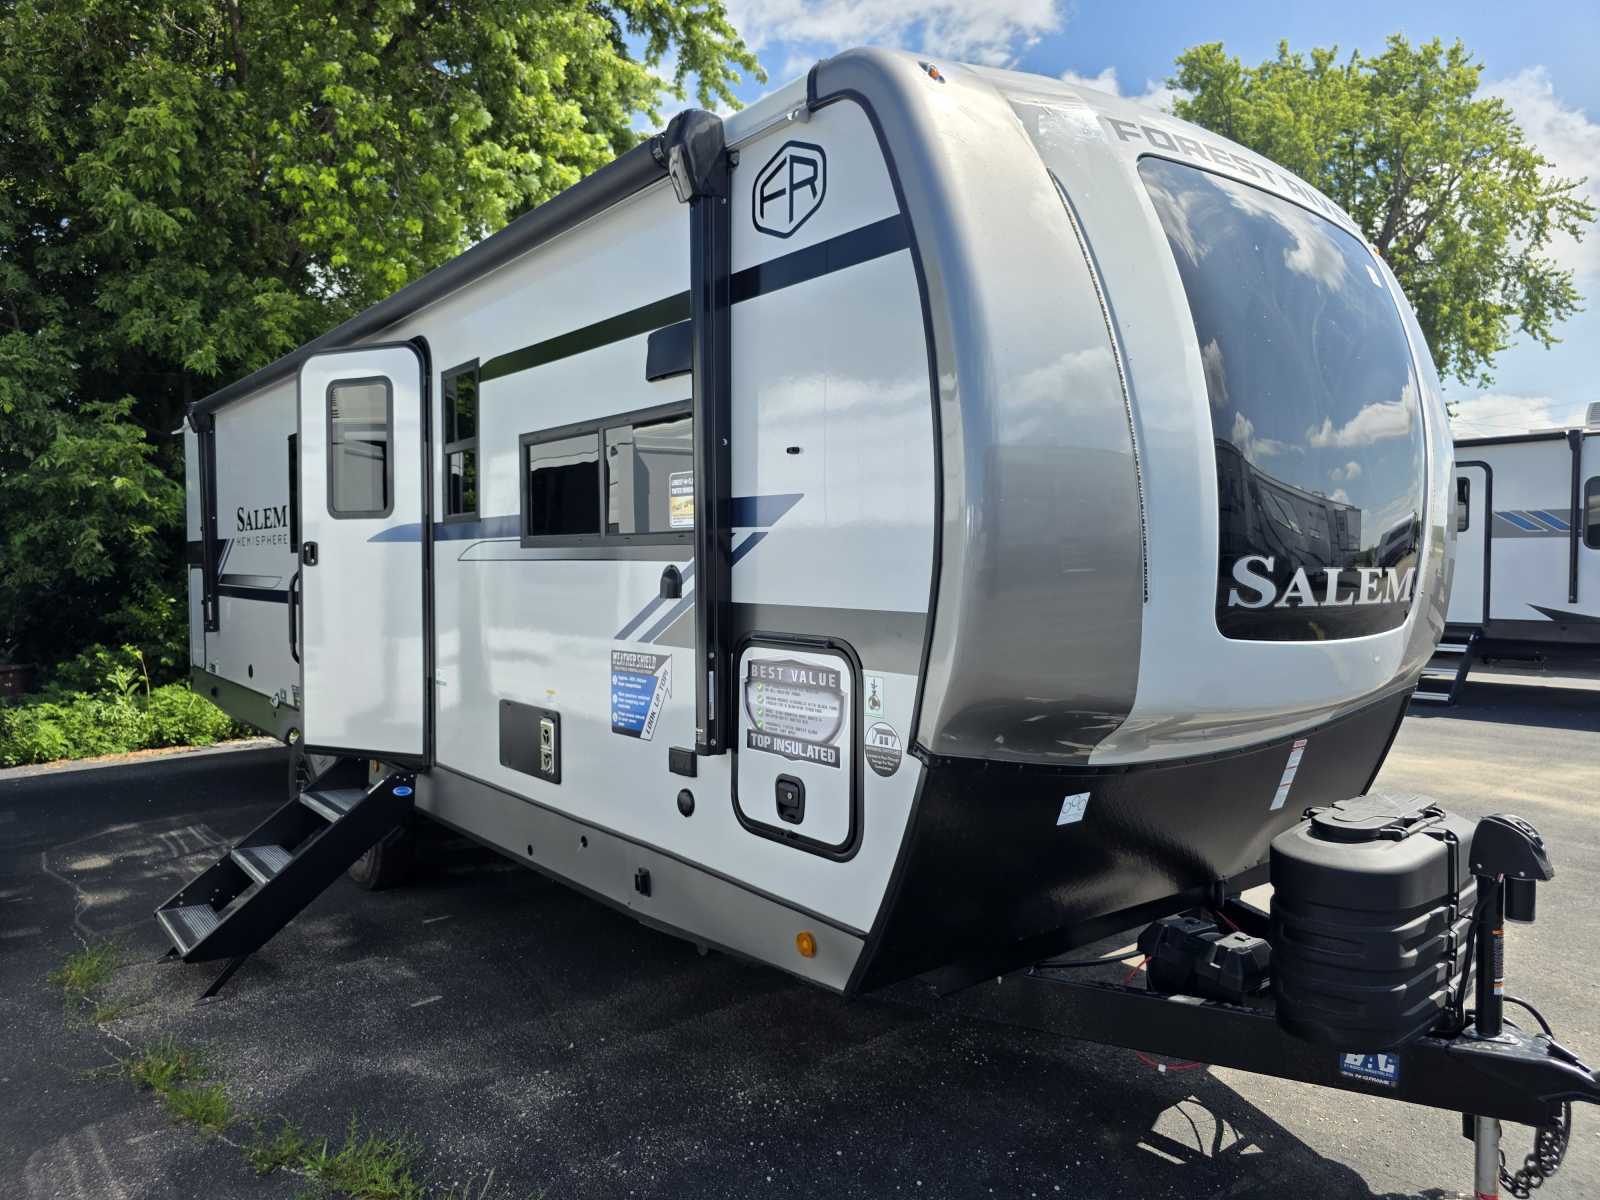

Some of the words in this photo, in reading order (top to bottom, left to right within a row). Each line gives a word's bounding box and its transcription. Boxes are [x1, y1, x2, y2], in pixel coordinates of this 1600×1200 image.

[1105, 117, 1276, 184] FOREST
[760, 154, 818, 224] FR
[237, 505, 288, 532] SALEM
[1228, 555, 1416, 609] SALEM
[751, 664, 784, 681] BEST
[791, 670, 837, 688] VALUE
[750, 733, 771, 749] TOP
[773, 738, 836, 763] INSULATED
